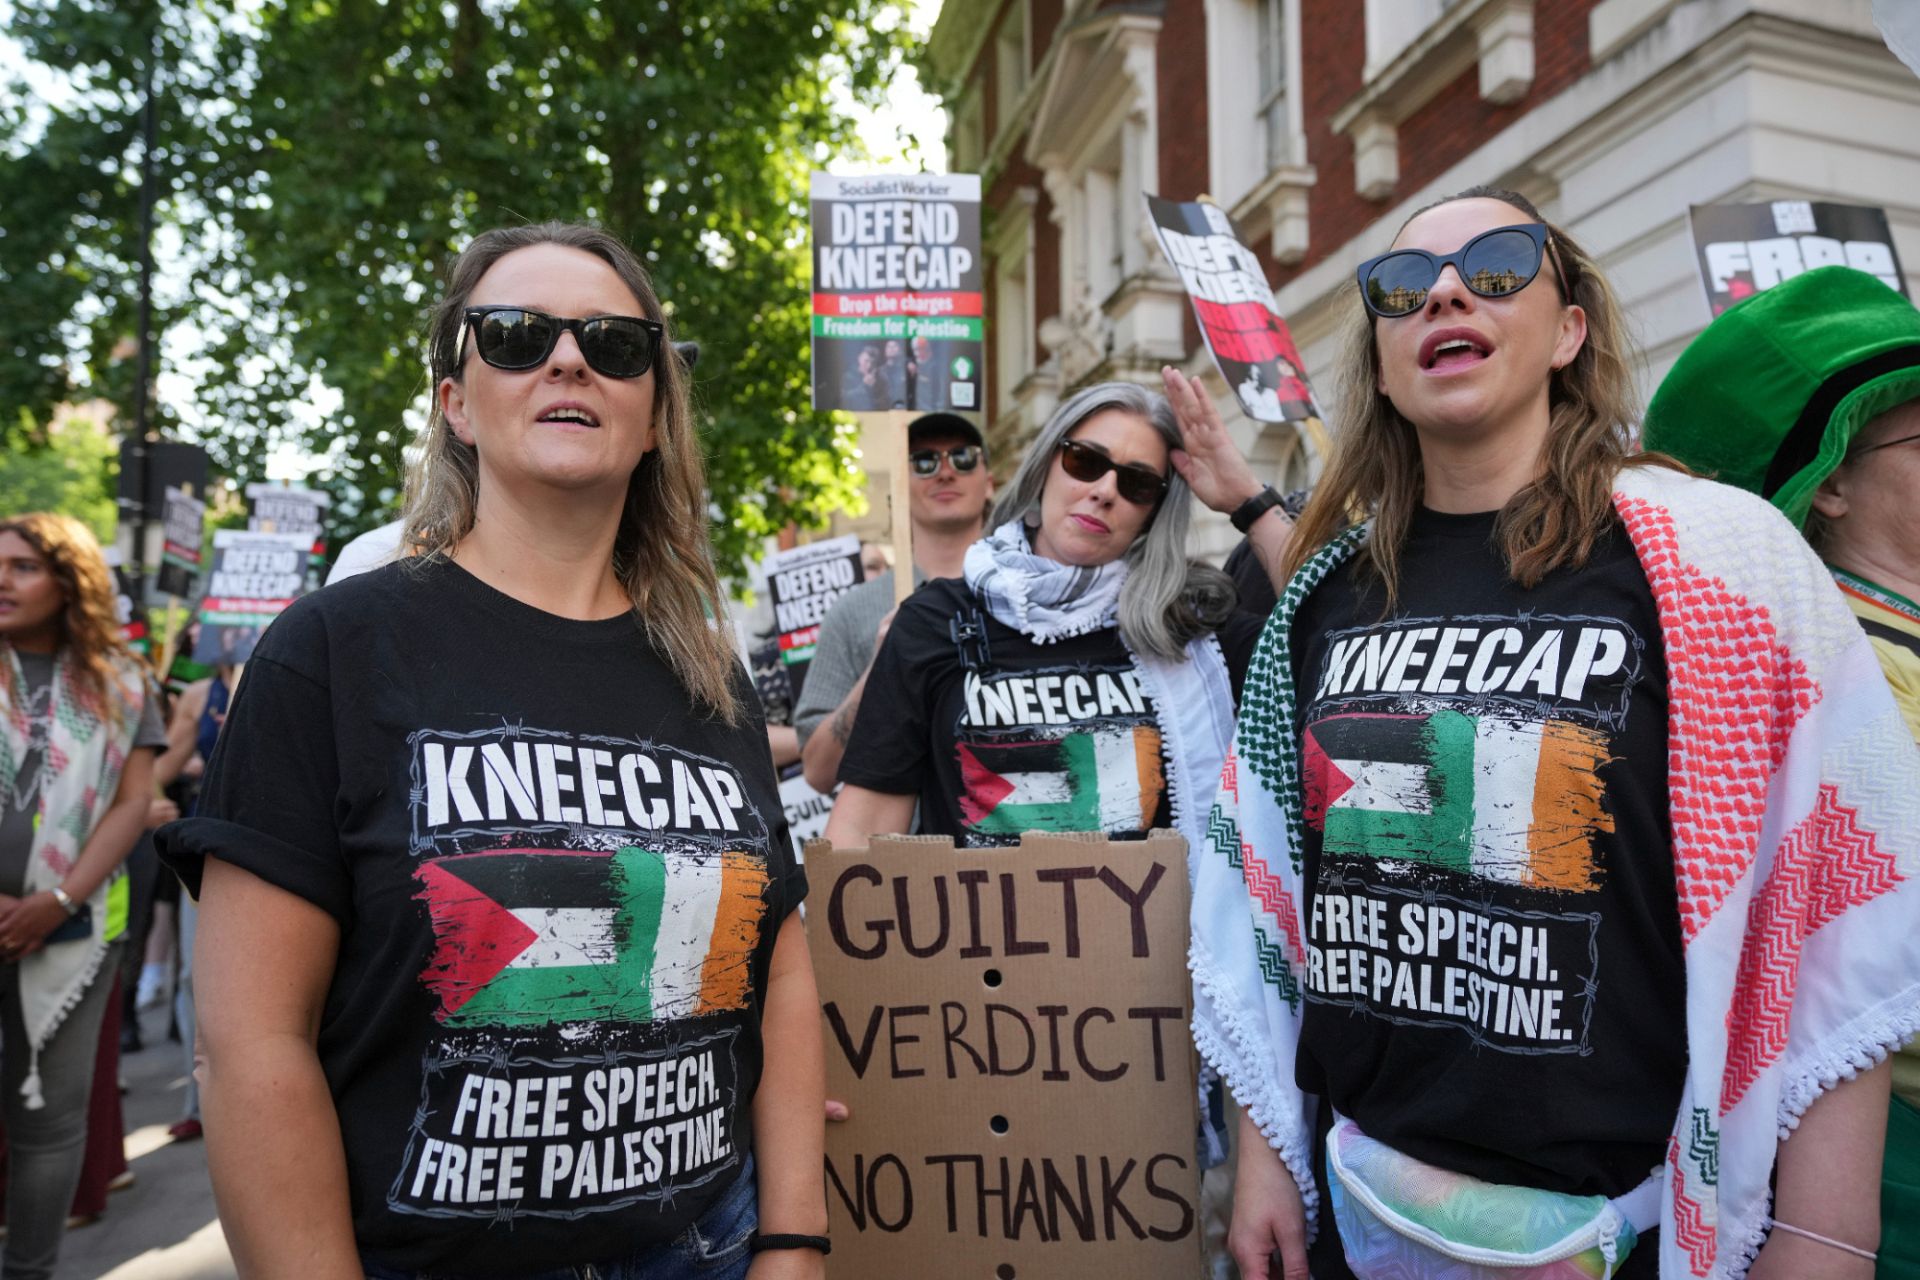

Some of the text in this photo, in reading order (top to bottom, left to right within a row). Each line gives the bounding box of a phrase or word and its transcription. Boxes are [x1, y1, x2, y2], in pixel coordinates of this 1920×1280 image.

[831, 200, 960, 246] DEFEND
[838, 180, 951, 196] Socialist Worker
[819, 245, 973, 290] KNEECAP
[823, 317, 970, 338] Freedom for Palestine
[838, 293, 954, 317] Drop the charges
[775, 557, 856, 602] DEFEND
[776, 586, 850, 633] KNEEC
[1316, 627, 1627, 701] KNEECAP
[423, 742, 743, 832] KNEECAP
[784, 788, 838, 828] GUIL
[827, 861, 1167, 960] GUILTY
[1311, 893, 1558, 983] FREE SPEECH.
[1373, 954, 1573, 1041] PALESTINE.
[822, 1001, 1184, 1082] VERDICT
[451, 1051, 720, 1140] FREE SPEECH.
[410, 1107, 731, 1204] FREE PALESTINE.
[824, 1152, 1196, 1242] NO THANKS
